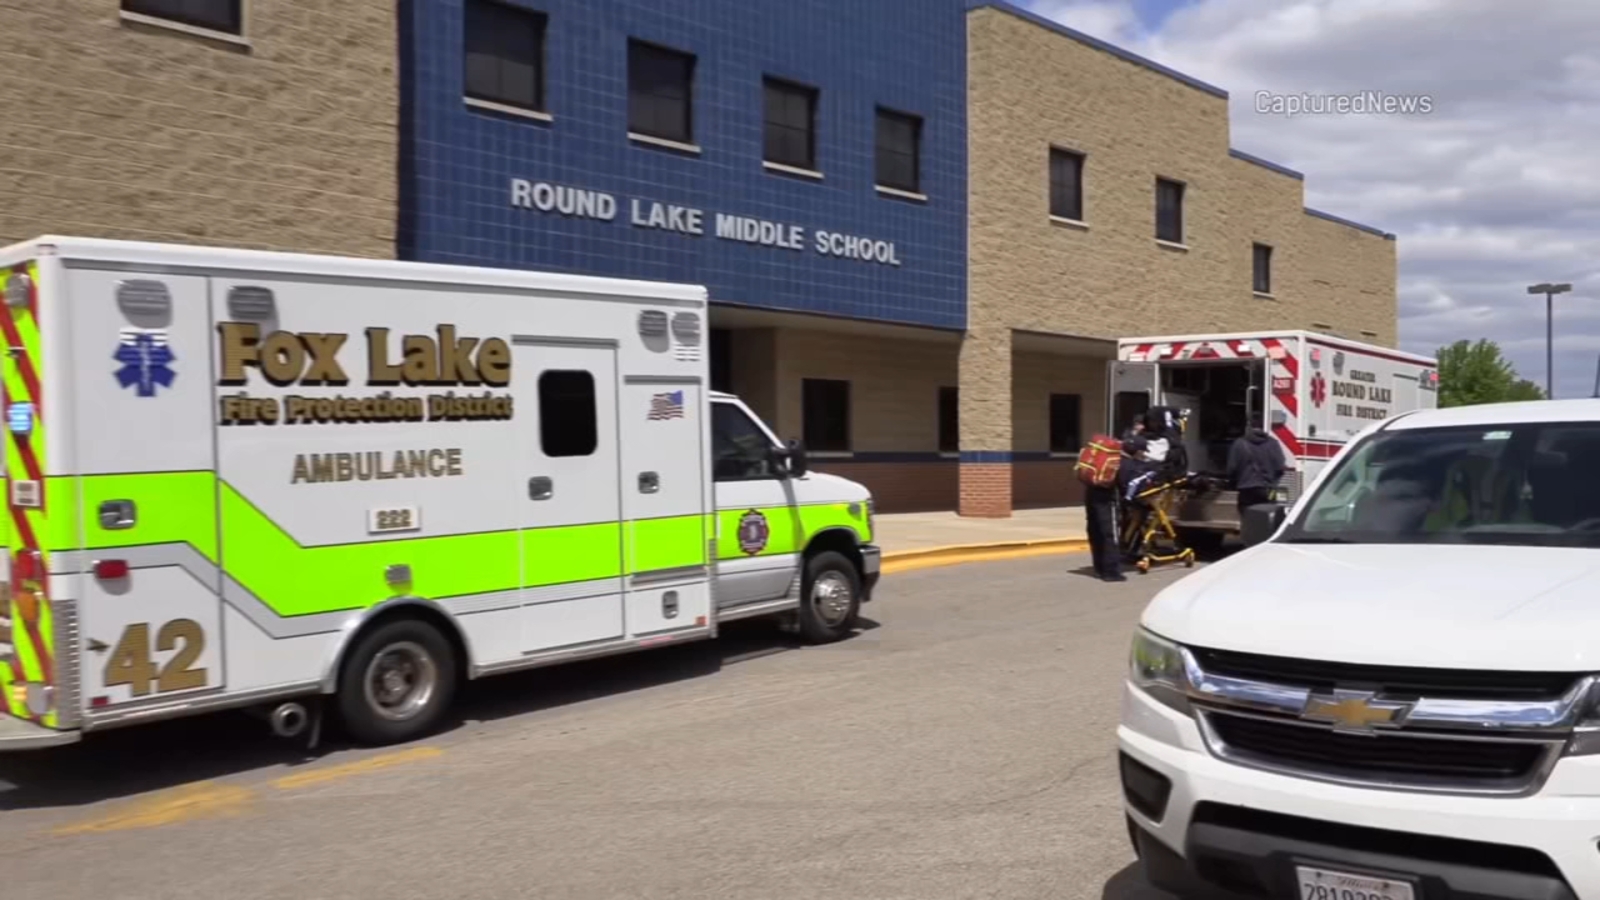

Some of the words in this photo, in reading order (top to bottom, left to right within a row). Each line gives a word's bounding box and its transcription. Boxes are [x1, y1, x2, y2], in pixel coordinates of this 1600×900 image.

[510, 178, 617, 221] ROUND
[630, 199, 703, 235] LAKE
[715, 213, 804, 250] MIDDLE
[814, 230, 901, 265] SCHOOL
[217, 321, 349, 386] Fox
[364, 323, 512, 386] Lake
[219, 390, 280, 426] Fire
[283, 390, 424, 424] Protection
[427, 390, 514, 421] District
[1332, 380, 1365, 400] ROUND
[1369, 386, 1391, 403] LAKE
[290, 448, 463, 484] AMBULANCE
[375, 509, 412, 530] 222
[103, 618, 208, 698] 42
